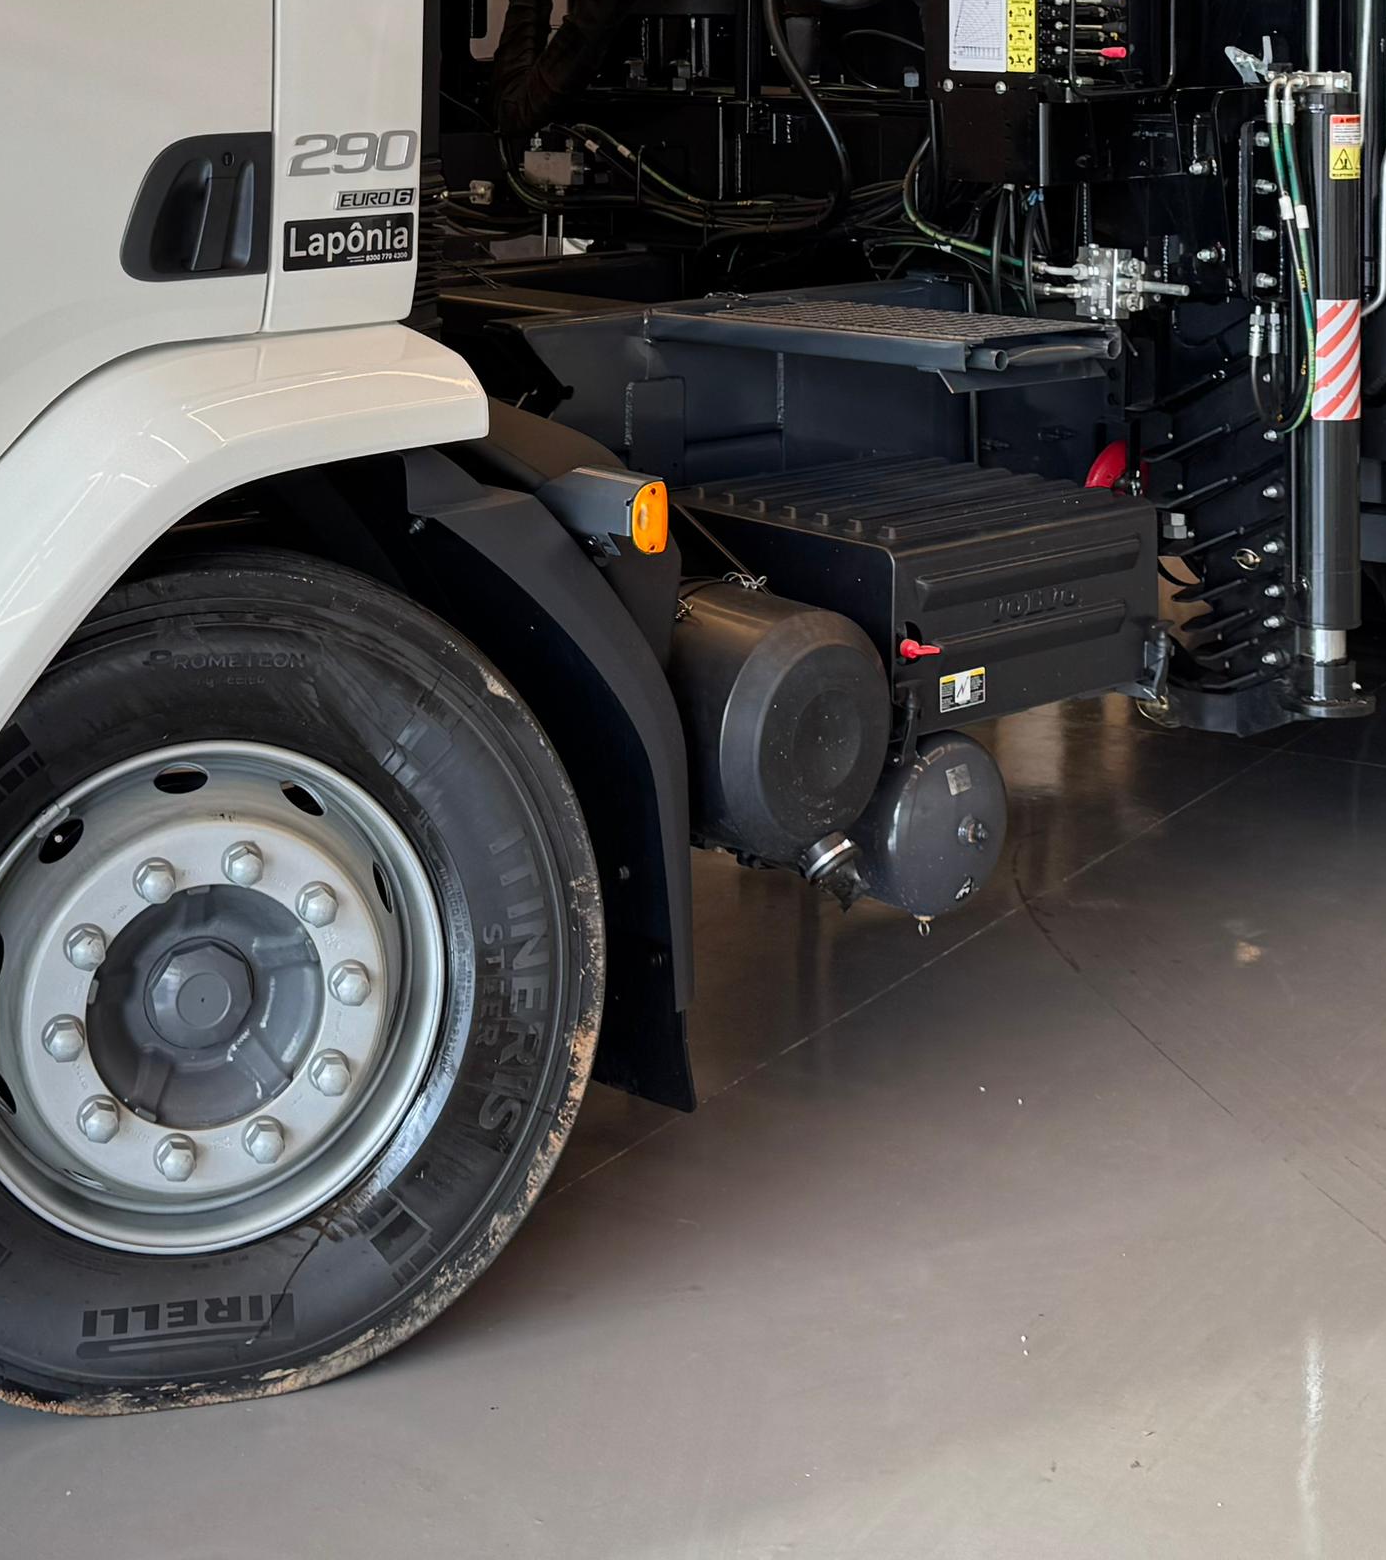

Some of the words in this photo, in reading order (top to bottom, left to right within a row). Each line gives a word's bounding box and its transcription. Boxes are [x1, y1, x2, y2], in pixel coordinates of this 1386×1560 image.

[286, 130, 418, 177] 290
[340, 191, 391, 208] EURO
[395, 189, 412, 204] 6
[289, 220, 409, 263] Lapônia
[142, 649, 306, 671] PROMETEON
[475, 923, 506, 1048] STEER
[76, 1293, 295, 1360] PIRELLI
